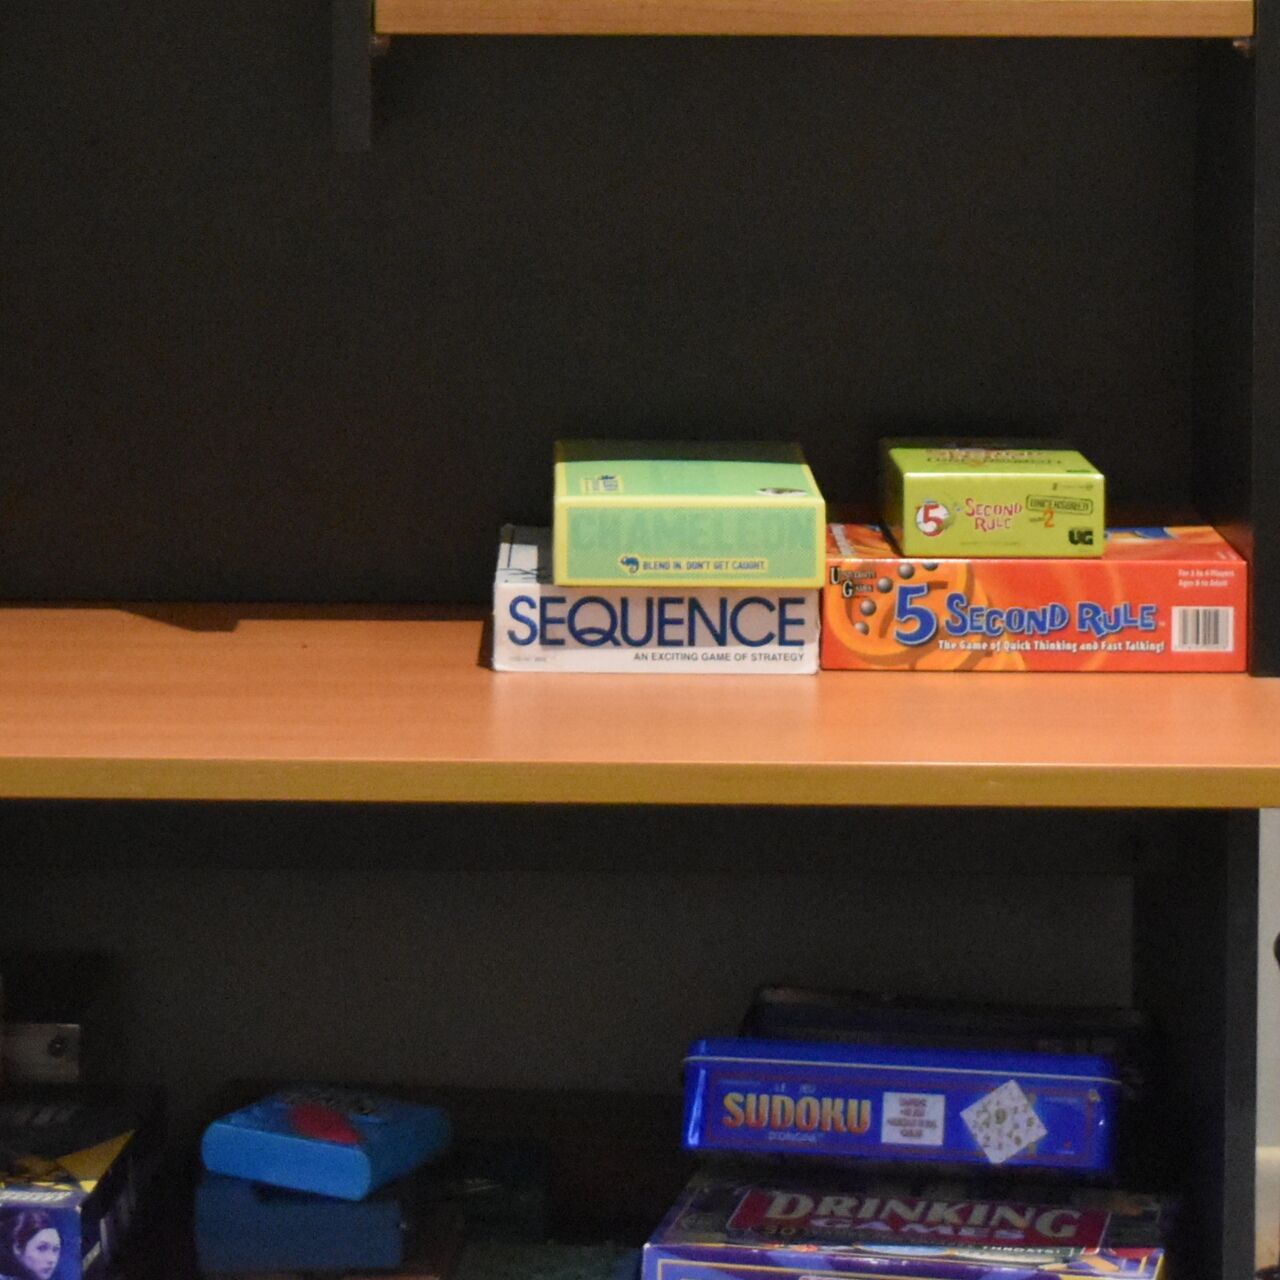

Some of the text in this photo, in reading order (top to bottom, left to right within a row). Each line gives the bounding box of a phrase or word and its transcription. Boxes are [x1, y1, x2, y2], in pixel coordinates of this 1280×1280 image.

[965, 498, 1023, 518] SECOND
[1043, 508, 1055, 528] 2
[923, 503, 945, 536] 5
[975, 517, 1011, 533] RULE
[570, 511, 814, 552] CHAMELEON
[1068, 530, 1094, 546] UG
[643, 561, 671, 571] BLEND
[686, 561, 711, 571] DON'T
[714, 561, 730, 571] GET
[507, 594, 806, 648] SEQUENCE
[893, 583, 1158, 645] 5 SECOND RULE
[938, 639, 1165, 653] The Game of Quick Thinking and Fast Talking!
[634, 653, 805, 662] AN EXCITING GAME OF STRATEGY
[722, 1091, 872, 1134] SUDOKU
[765, 1190, 1082, 1240] DRINKING
[810, 1216, 1027, 1241] GAMES
